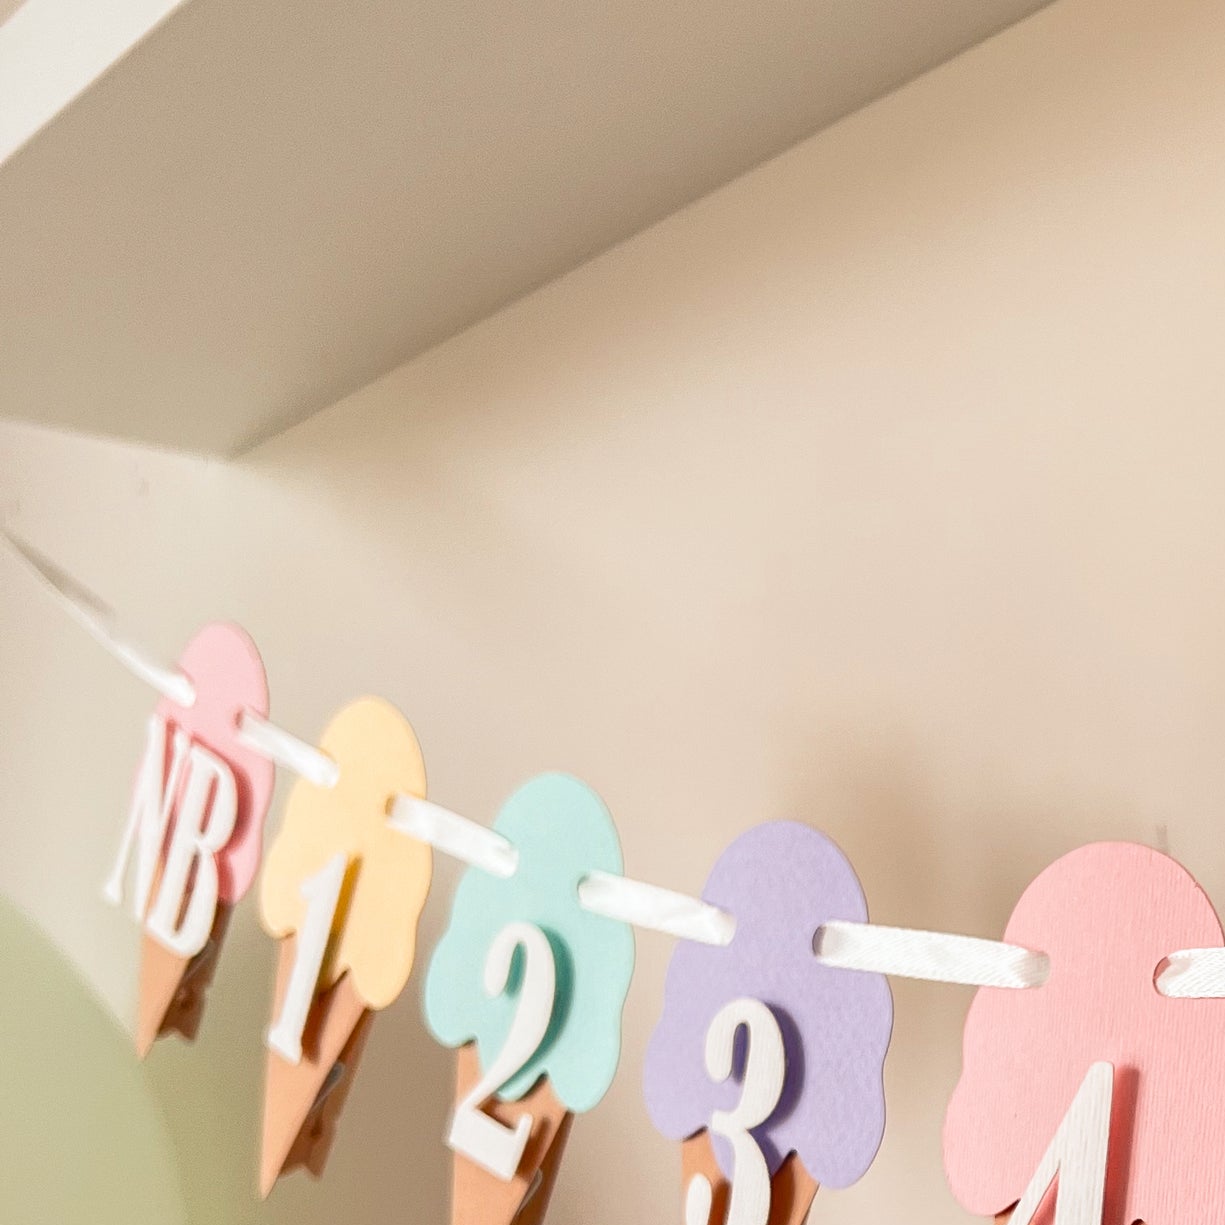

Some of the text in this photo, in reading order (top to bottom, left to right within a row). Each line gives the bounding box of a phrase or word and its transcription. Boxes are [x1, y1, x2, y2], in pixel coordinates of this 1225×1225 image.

[105, 713, 239, 958] NB
[268, 851, 351, 1065] 1
[448, 922, 557, 1180] 2
